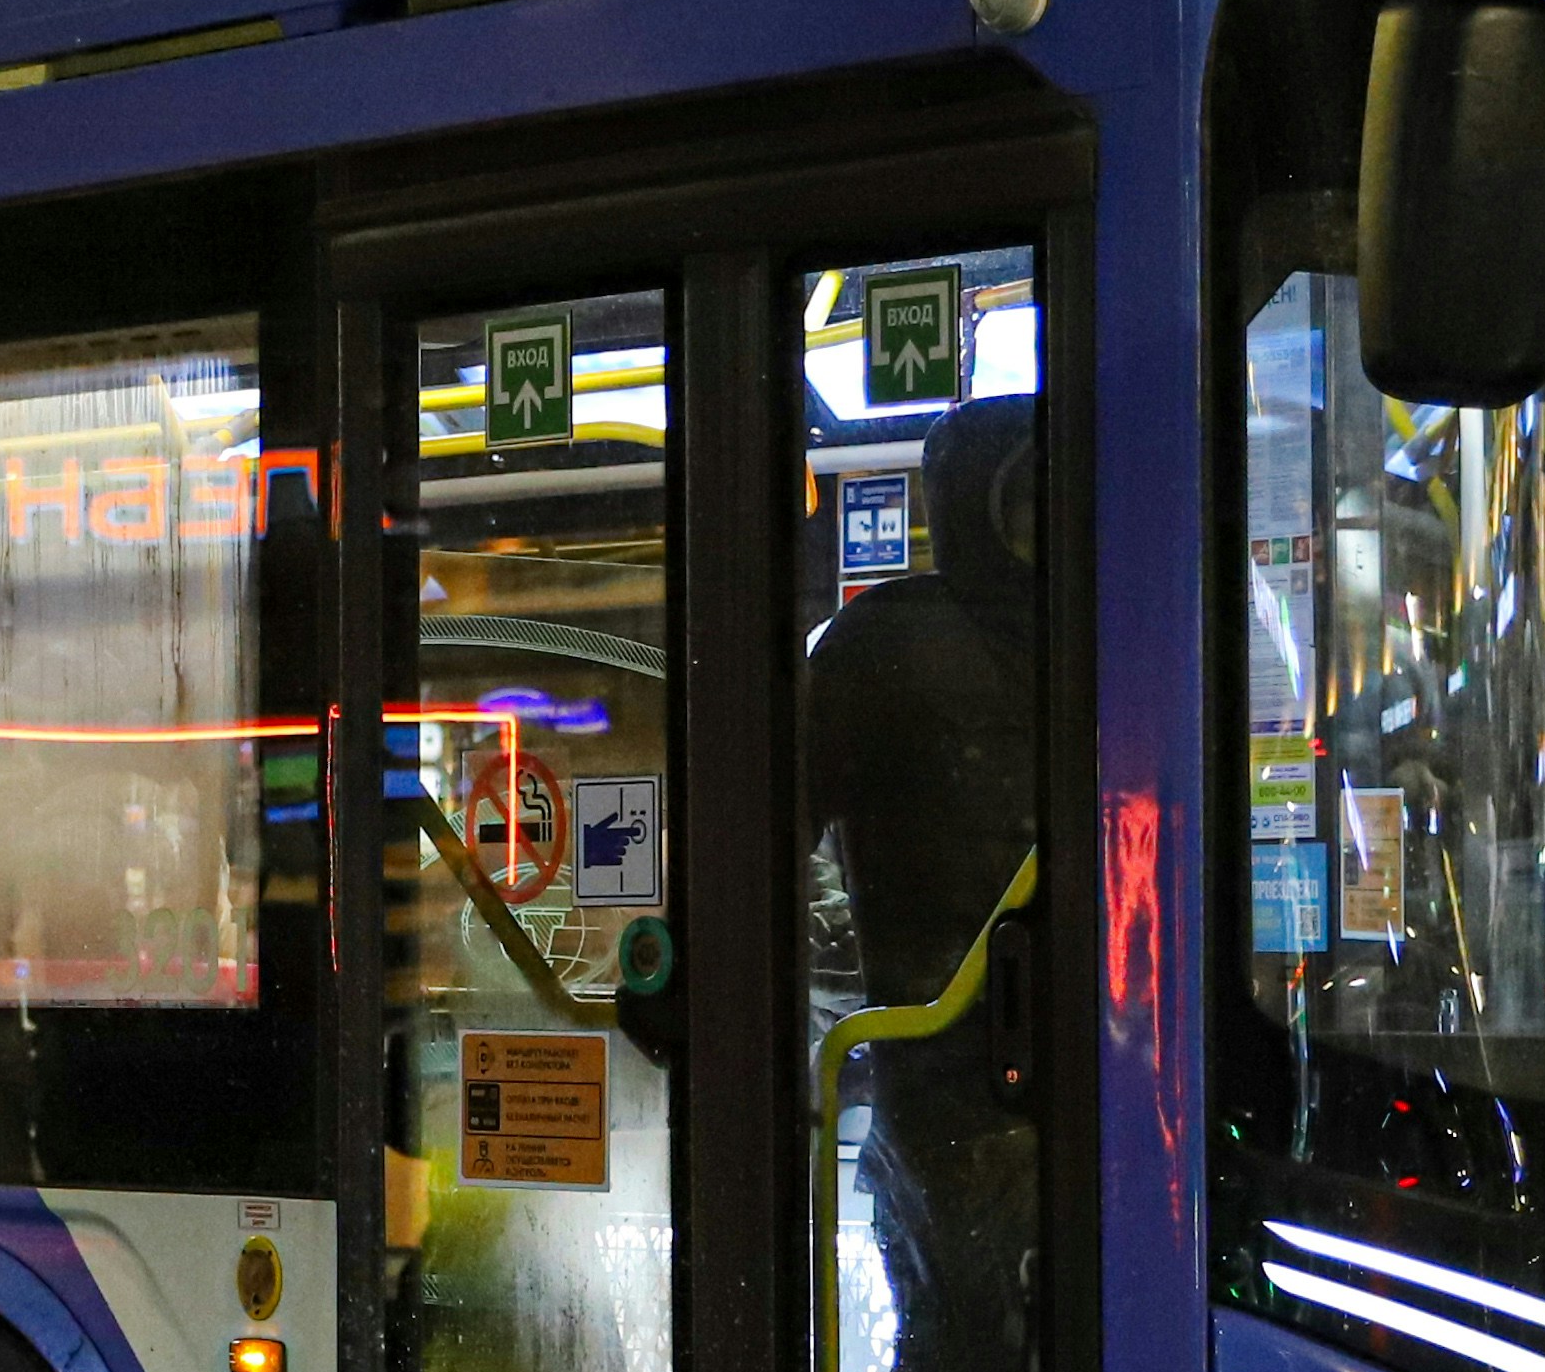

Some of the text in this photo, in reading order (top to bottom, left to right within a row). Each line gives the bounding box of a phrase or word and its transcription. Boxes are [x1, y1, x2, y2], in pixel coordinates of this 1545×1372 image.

[885, 301, 935, 329] ВХОД
[507, 346, 550, 370] ВХОД
[107, 906, 249, 993] 3201
